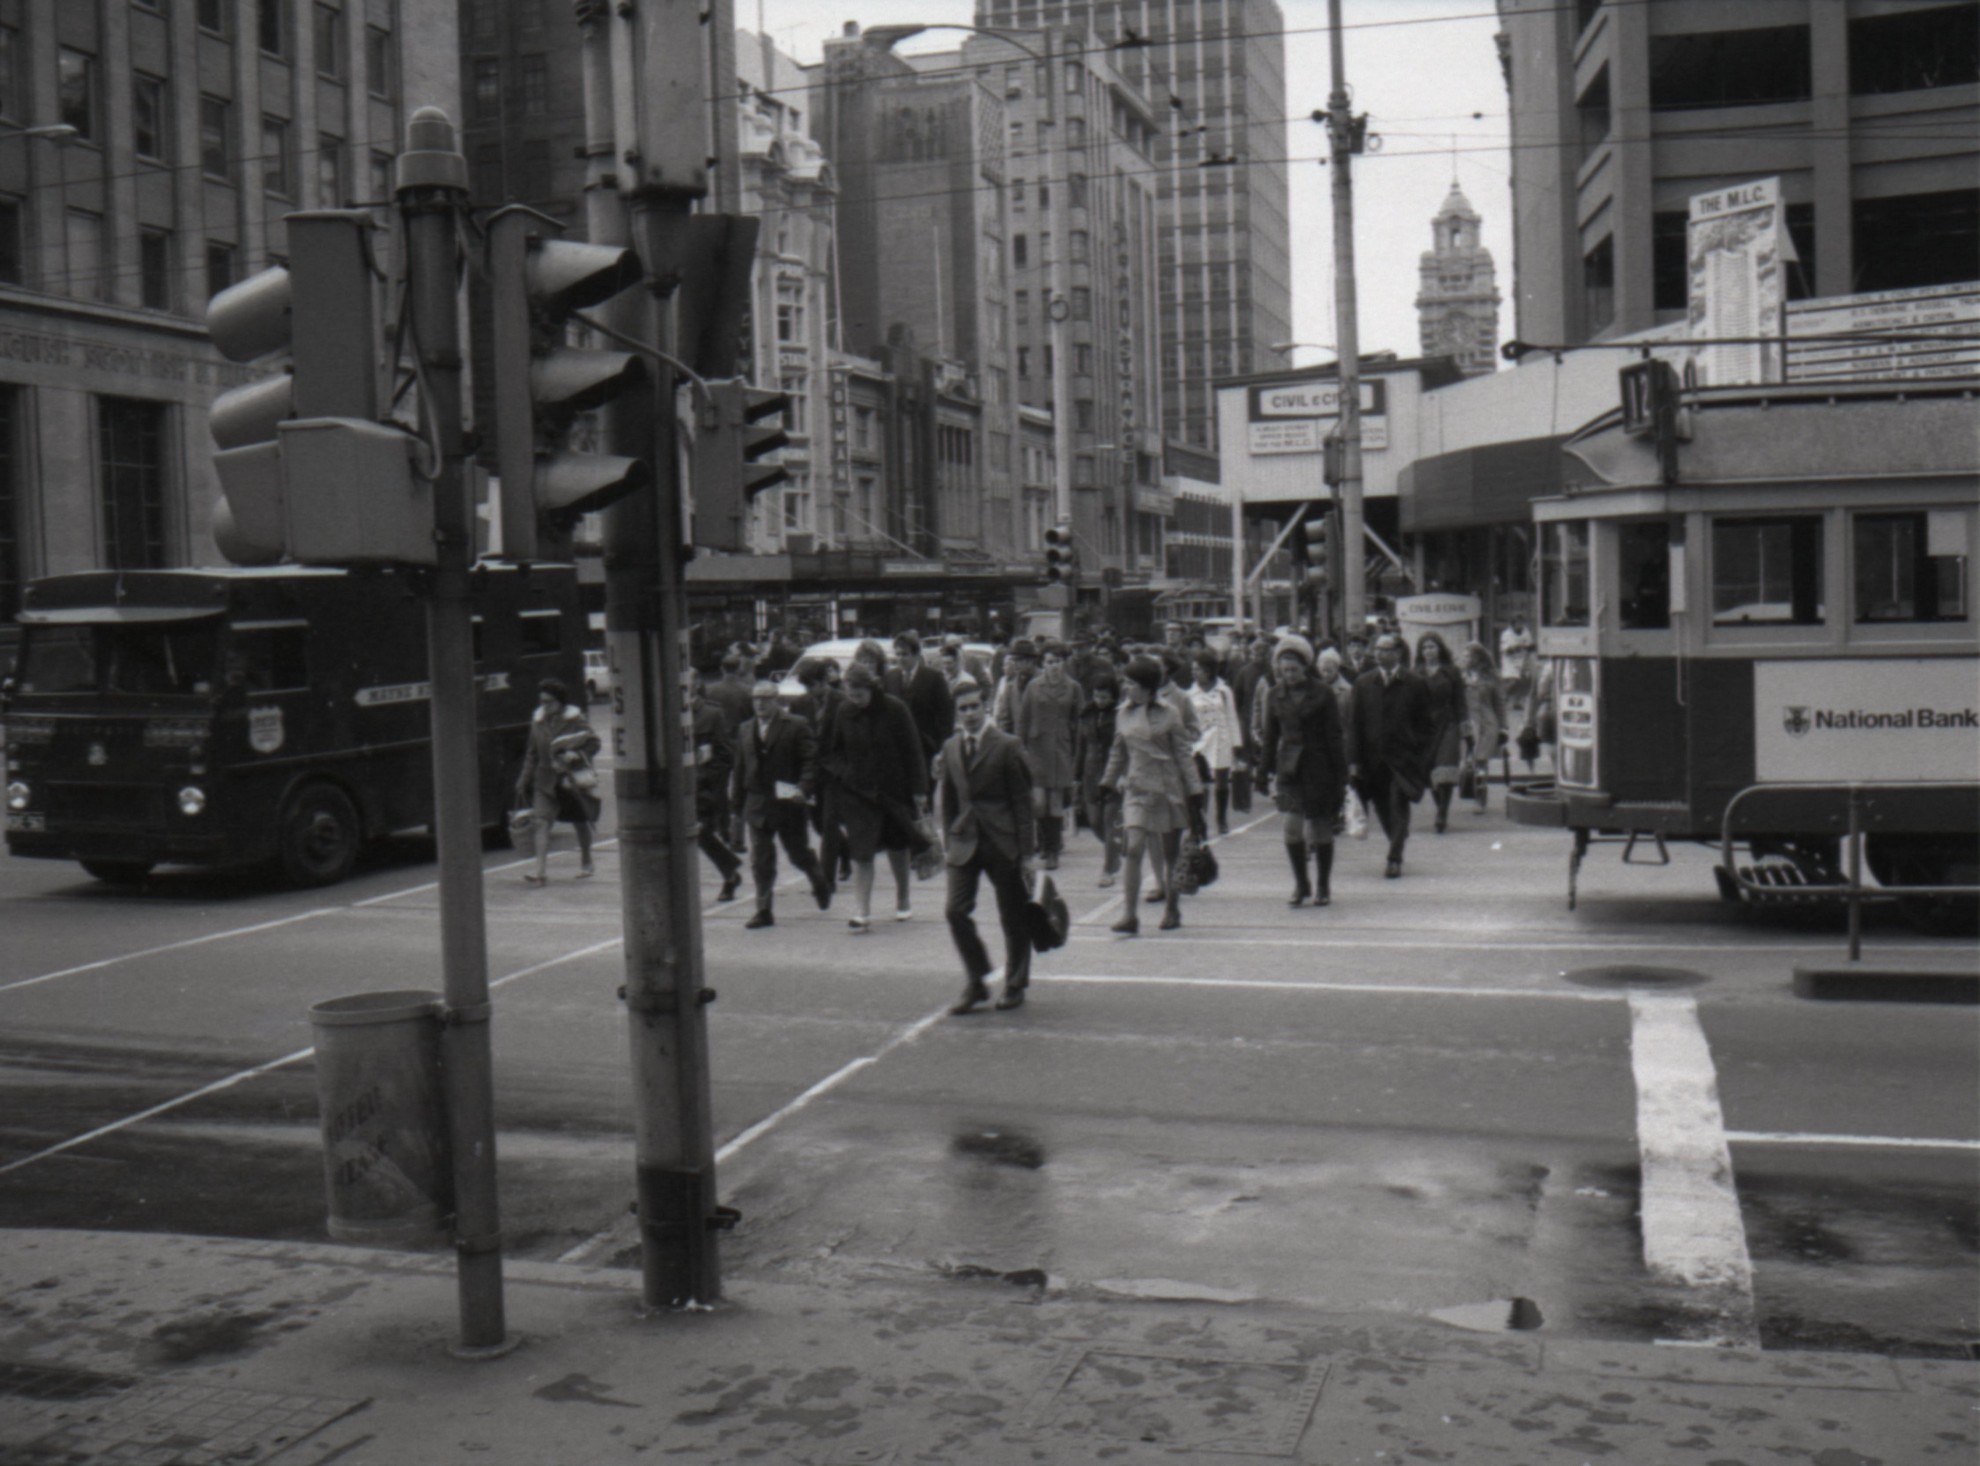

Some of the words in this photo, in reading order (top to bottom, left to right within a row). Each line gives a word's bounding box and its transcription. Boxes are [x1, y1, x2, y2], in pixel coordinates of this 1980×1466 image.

[1699, 194, 1721, 215] THE
[1726, 185, 1767, 209] M.L.C.
[1271, 394, 1309, 409] CIVIL
[1815, 708, 1914, 730] National
[1917, 707, 1979, 729] Bank
